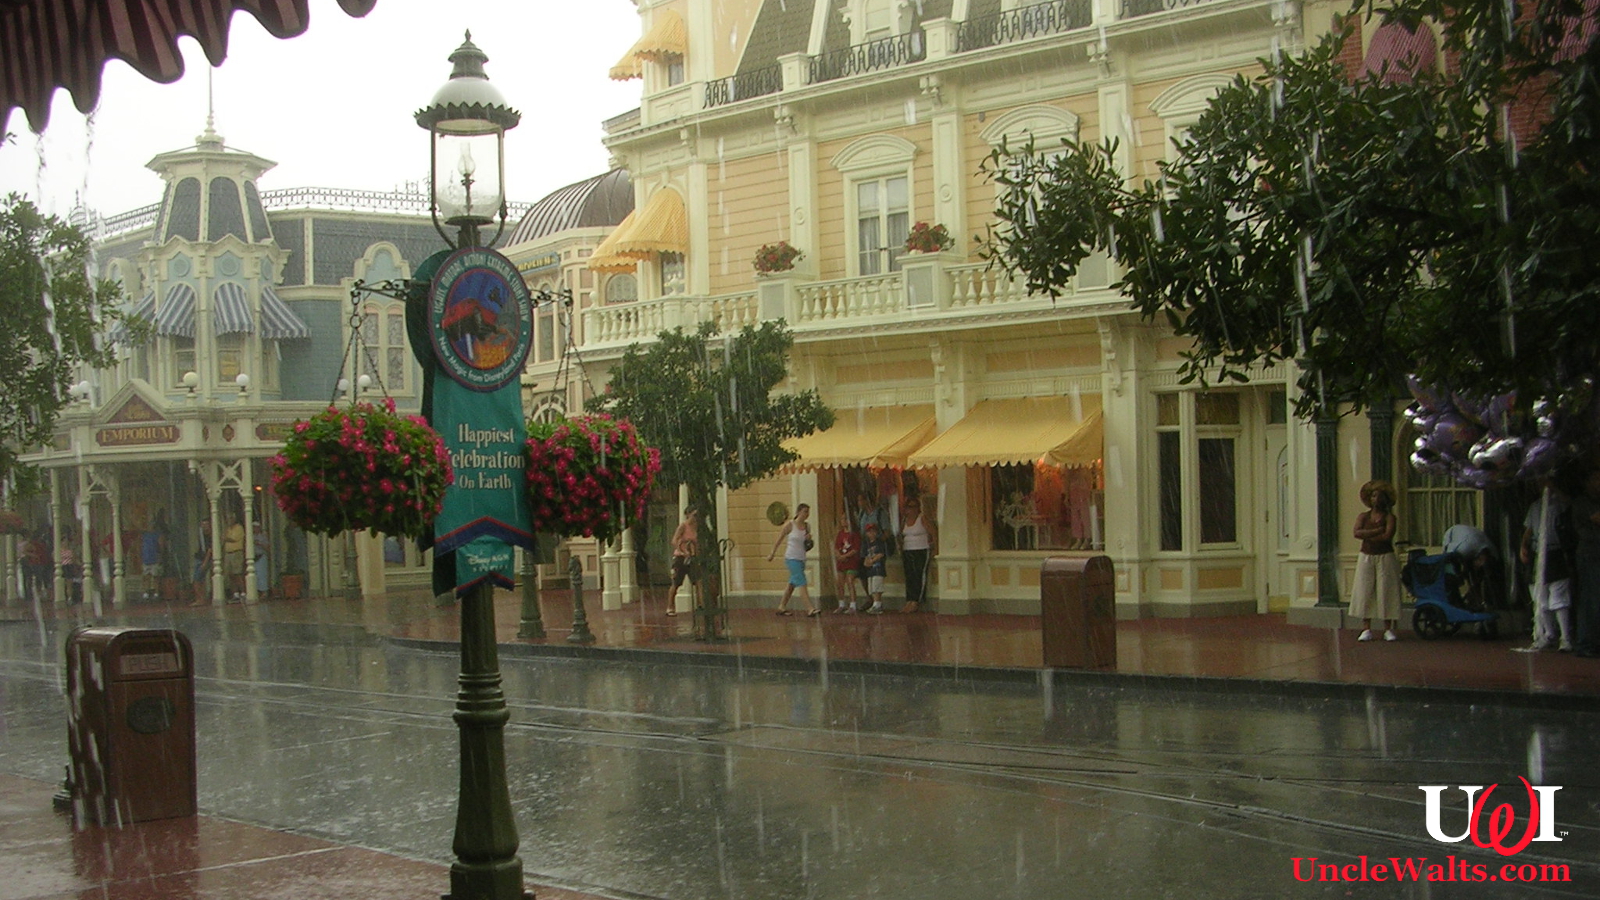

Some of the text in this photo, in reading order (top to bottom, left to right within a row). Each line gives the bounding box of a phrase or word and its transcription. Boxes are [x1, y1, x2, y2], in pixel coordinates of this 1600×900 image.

[438, 337, 525, 383] New Magic from Disneyland Paris
[102, 427, 173, 442] EMPORIUM
[458, 423, 514, 448] Happiest
[445, 447, 526, 469] elebration
[460, 471, 512, 489] On Earth
